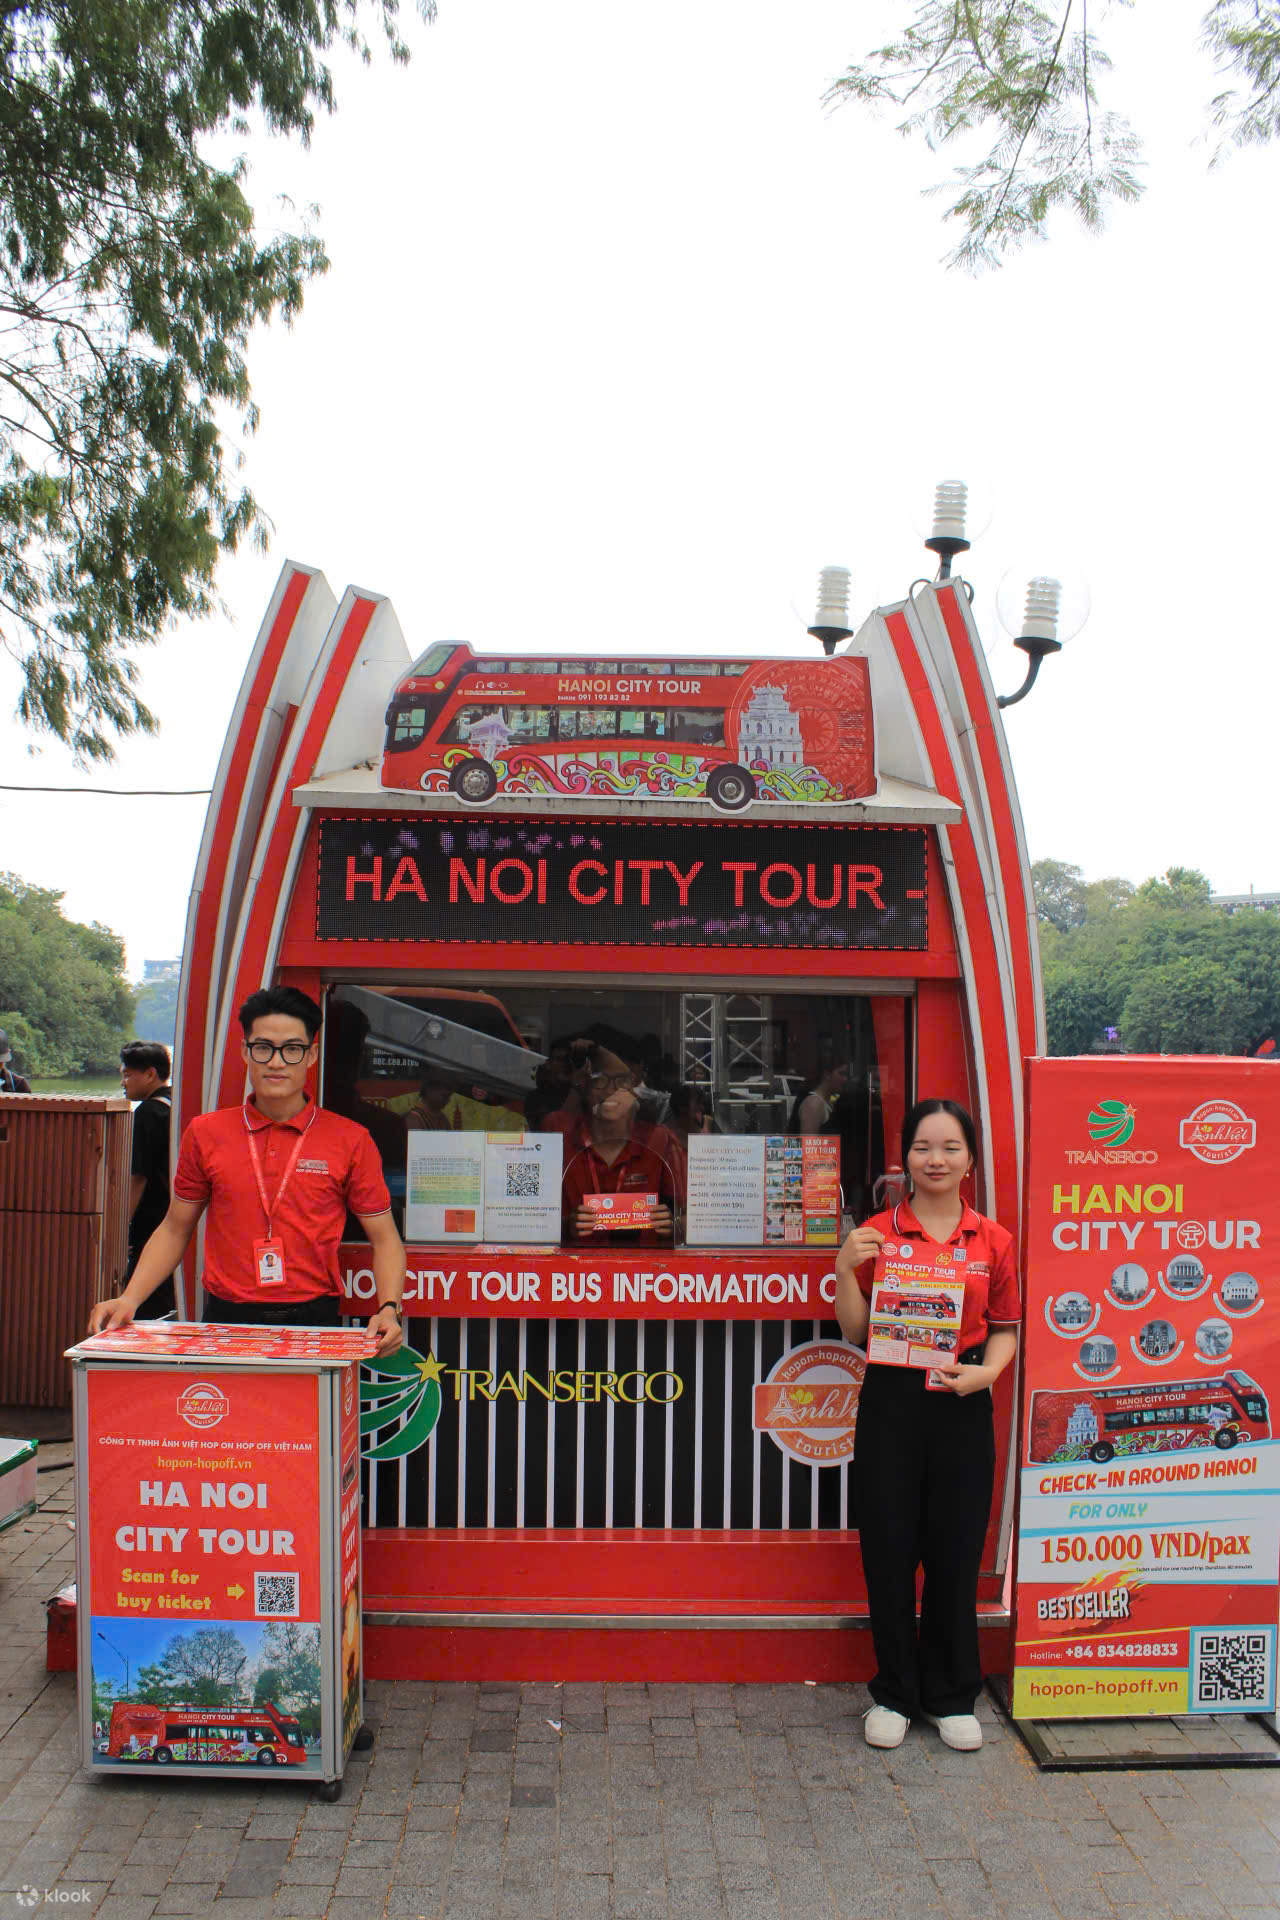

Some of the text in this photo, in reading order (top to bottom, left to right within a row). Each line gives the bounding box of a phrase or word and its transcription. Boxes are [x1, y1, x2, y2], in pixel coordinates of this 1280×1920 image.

[558, 680, 701, 694] HANOI CITY TOUR
[346, 856, 428, 902] HA
[449, 858, 547, 904] NOI
[568, 860, 704, 906] CITY
[722, 862, 885, 909] TOUR
[1064, 1150, 1158, 1165] TRANSERCO
[1052, 1184, 1184, 1214] HANOI
[1052, 1221, 1145, 1251] CITY
[913, 1264, 933, 1273] CITY
[401, 1270, 457, 1300] CITY
[468, 1272, 541, 1302] TOUR
[551, 1272, 602, 1302] BUS
[613, 1273, 809, 1303] INFORMATION
[445, 1370, 684, 1403] TRANSERCO
[1145, 1395, 1162, 1404] CITY
[1165, 1393, 1186, 1401] TOUR
[99, 1436, 124, 1445] CÔNG
[126, 1438, 136, 1446] TY
[137, 1439, 160, 1447] TNHH
[200, 1441, 219, 1449] HOP
[236, 1442, 255, 1450] HOP
[256, 1442, 272, 1450] OFF
[157, 1456, 252, 1472] hopon-hopoff.vn
[1128, 1463, 1201, 1487] AROUND
[1203, 1457, 1257, 1479] HANOI
[139, 1480, 268, 1509] HA NOI
[1069, 1503, 1149, 1520] FOR ONLY
[115, 1526, 296, 1556] CITY TOUR
[1040, 1531, 1251, 1564] 150.000 VND/pax
[121, 1568, 200, 1585] Scan for
[117, 1592, 212, 1612] buy ticket
[1037, 1586, 1130, 1620] BESTSELLER
[1030, 1643, 1178, 1660] Hotline: +84 834828833
[1030, 1679, 1179, 1699] hopon-hopoff.vn
